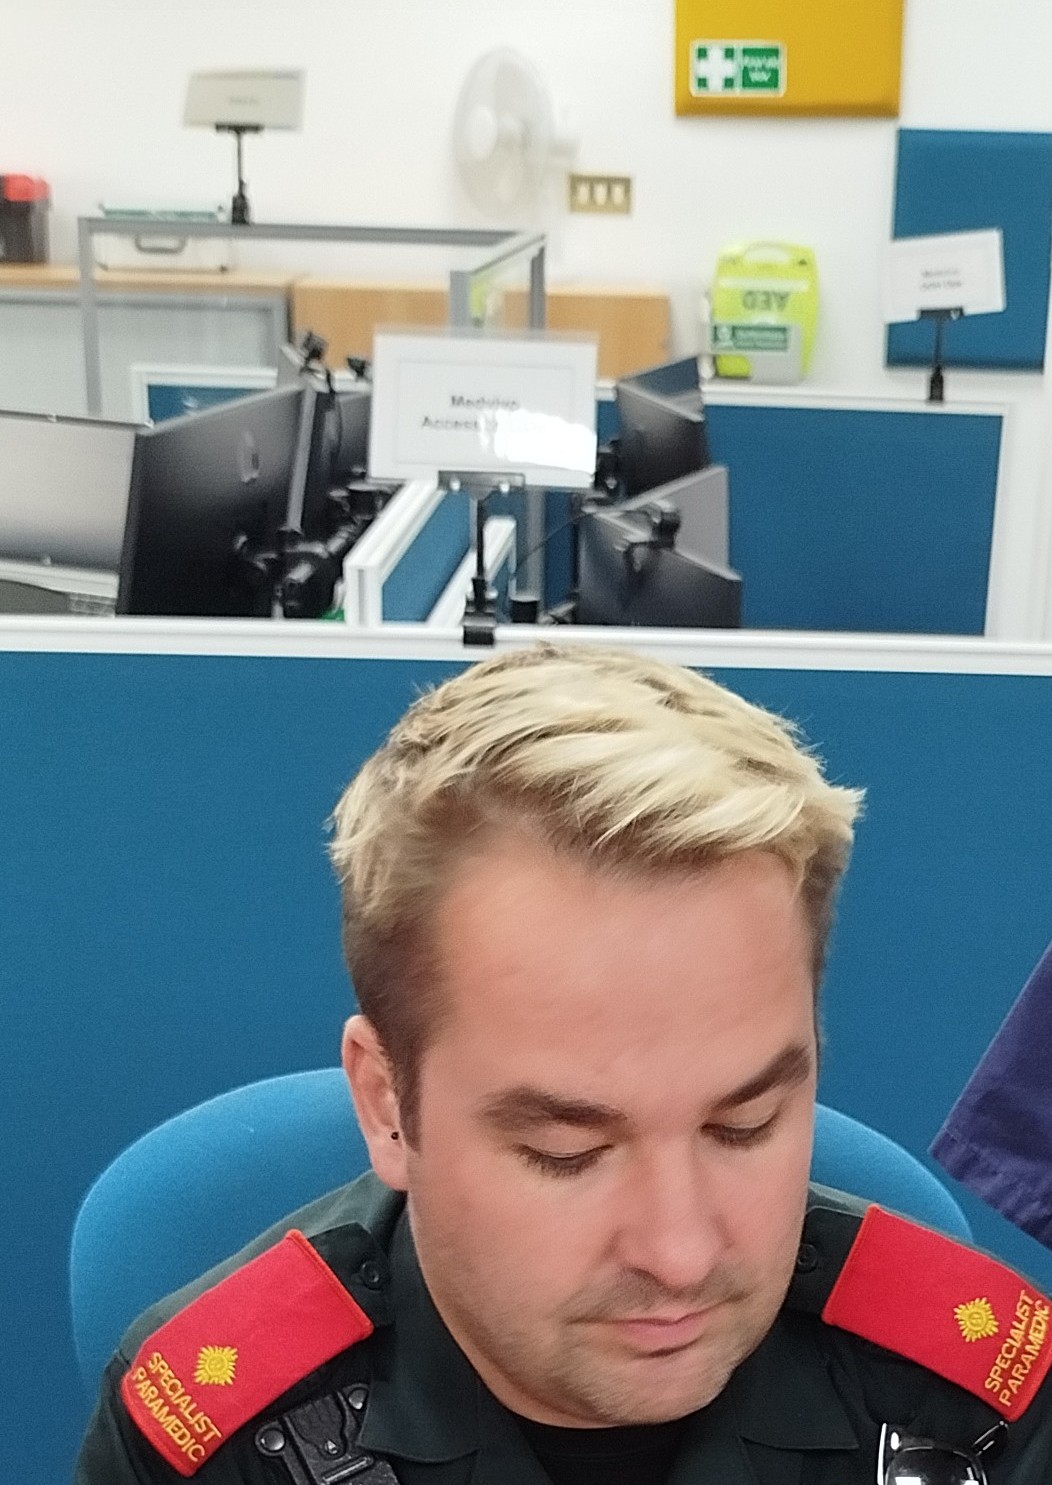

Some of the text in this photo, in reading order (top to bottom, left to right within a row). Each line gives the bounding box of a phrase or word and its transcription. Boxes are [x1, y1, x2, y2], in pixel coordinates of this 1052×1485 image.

[743, 290, 791, 311] AED
[985, 1289, 1035, 1393] SPECIALIST
[998, 1299, 1050, 1407] PARAMEDIC
[131, 1367, 205, 1463] PARAMEDIC
[148, 1351, 222, 1441] SPECIALIST
